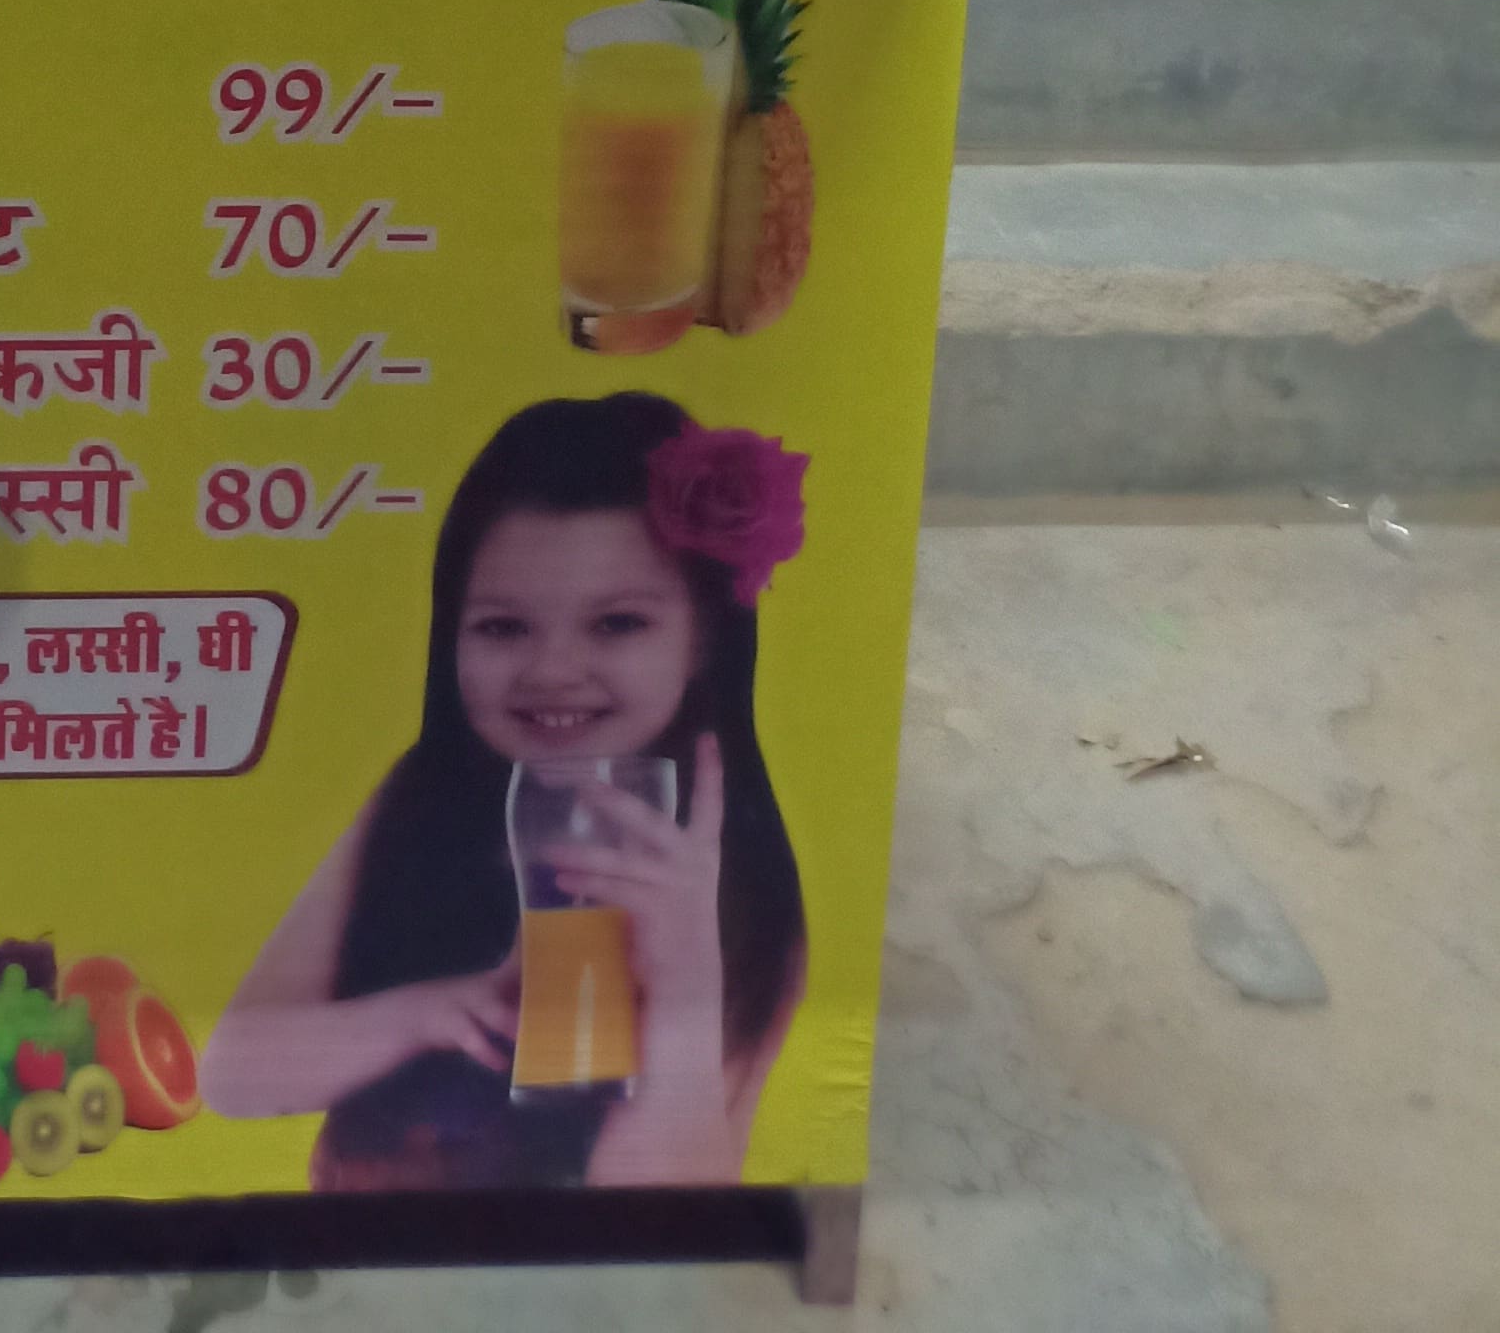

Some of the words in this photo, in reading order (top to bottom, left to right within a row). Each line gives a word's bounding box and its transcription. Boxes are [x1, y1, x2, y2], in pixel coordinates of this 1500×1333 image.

[219, 68, 434, 135] 99/-
[214, 204, 427, 269] 70/-
[209, 337, 420, 402] 30/-
[205, 468, 416, 533] 80/-
[198, 611, 255, 672] घी
